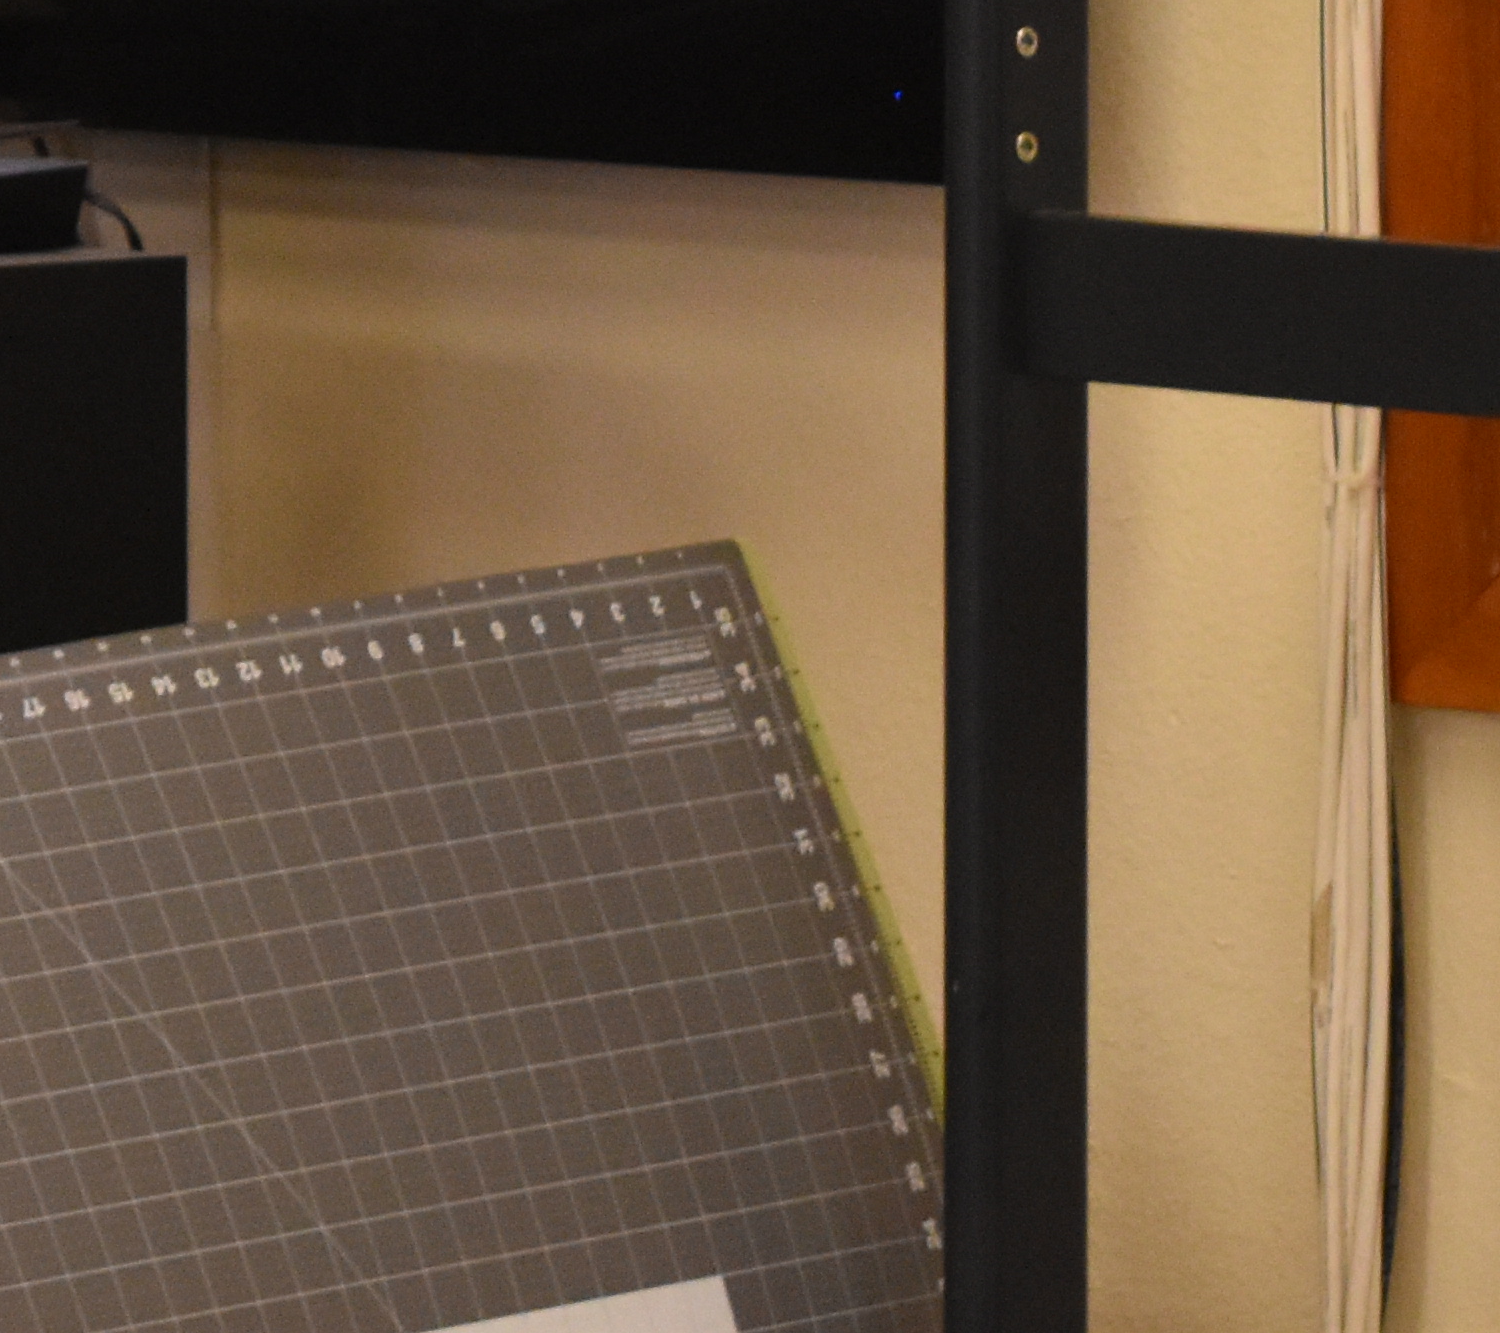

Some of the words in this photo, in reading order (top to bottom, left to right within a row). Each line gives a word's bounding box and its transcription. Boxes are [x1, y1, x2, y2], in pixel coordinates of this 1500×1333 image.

[648, 595, 665, 617] 2
[689, 589, 702, 610] 1
[569, 608, 585, 629] 4
[609, 601, 626, 623] 3
[490, 619, 507, 642] 6
[529, 614, 546, 636] 5
[452, 627, 467, 649] 7
[321, 646, 347, 670] 10
[367, 640, 384, 662] 9
[235, 661, 262, 683] 12
[279, 653, 302, 677] 11
[151, 675, 178, 697] 14
[194, 667, 220, 690] 13
[64, 689, 92, 711] 16
[108, 682, 134, 704] 15
[23, 696, 46, 720] 17
